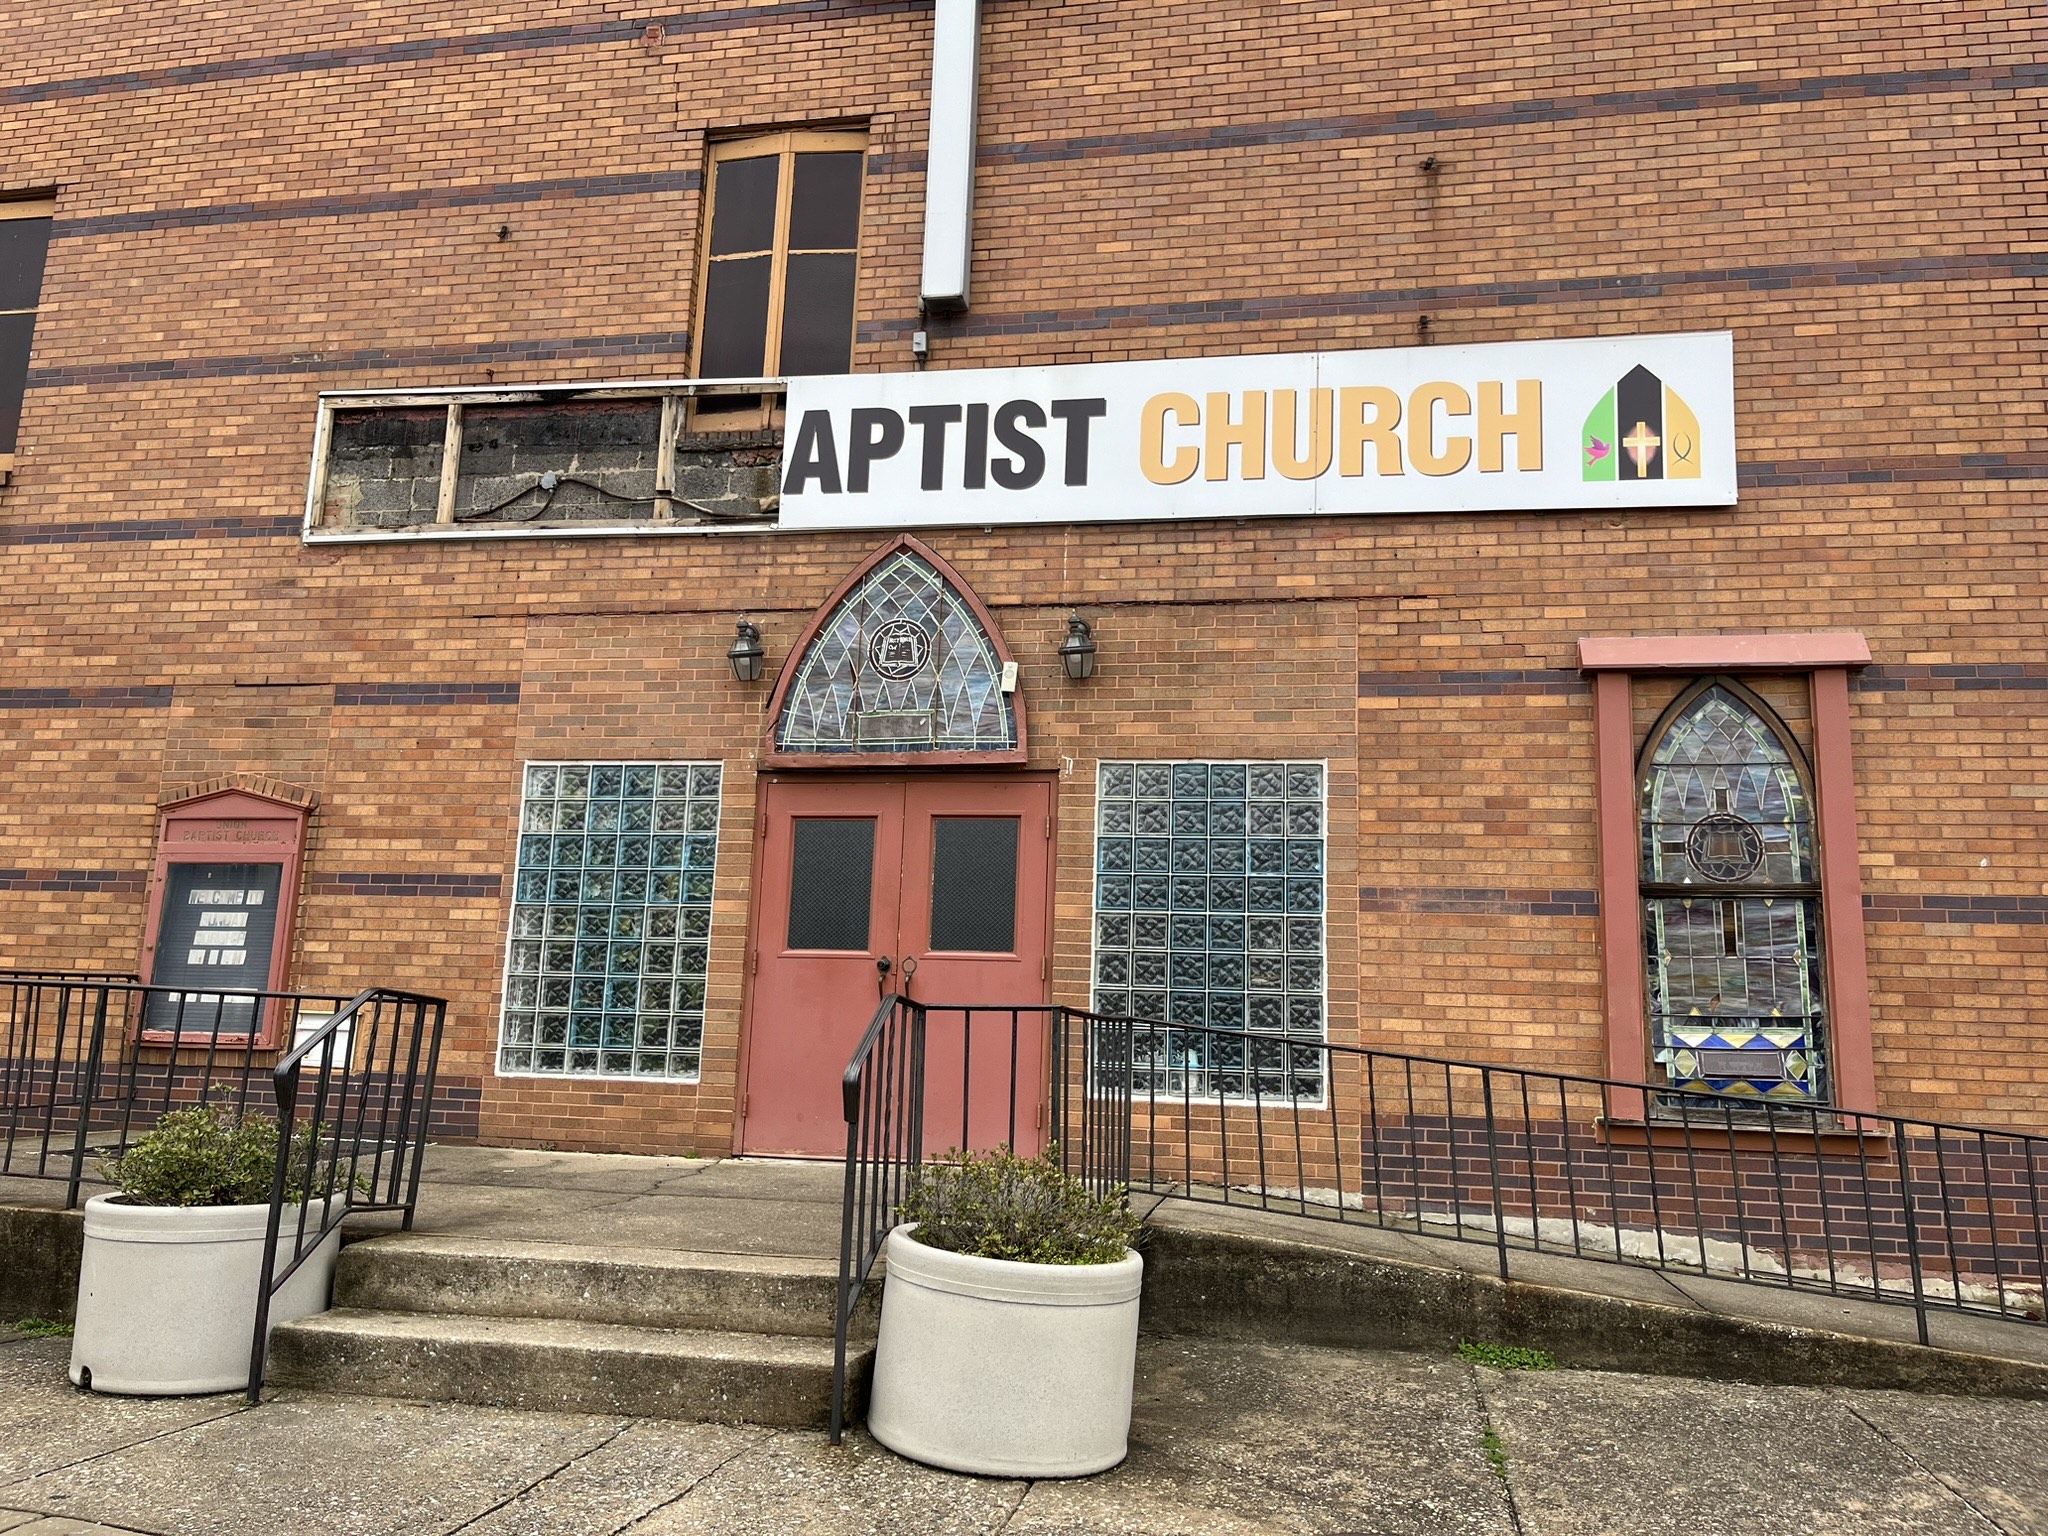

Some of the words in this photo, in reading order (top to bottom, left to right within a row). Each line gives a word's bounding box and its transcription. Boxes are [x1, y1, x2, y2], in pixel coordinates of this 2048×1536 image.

[782, 398, 1106, 494] APTIST
[1140, 379, 1543, 484] CHURCH
[216, 820, 248, 829] UNION
[183, 830, 230, 841] BAPTIST
[235, 830, 280, 841] CHURCH
[190, 890, 243, 904] WECME
